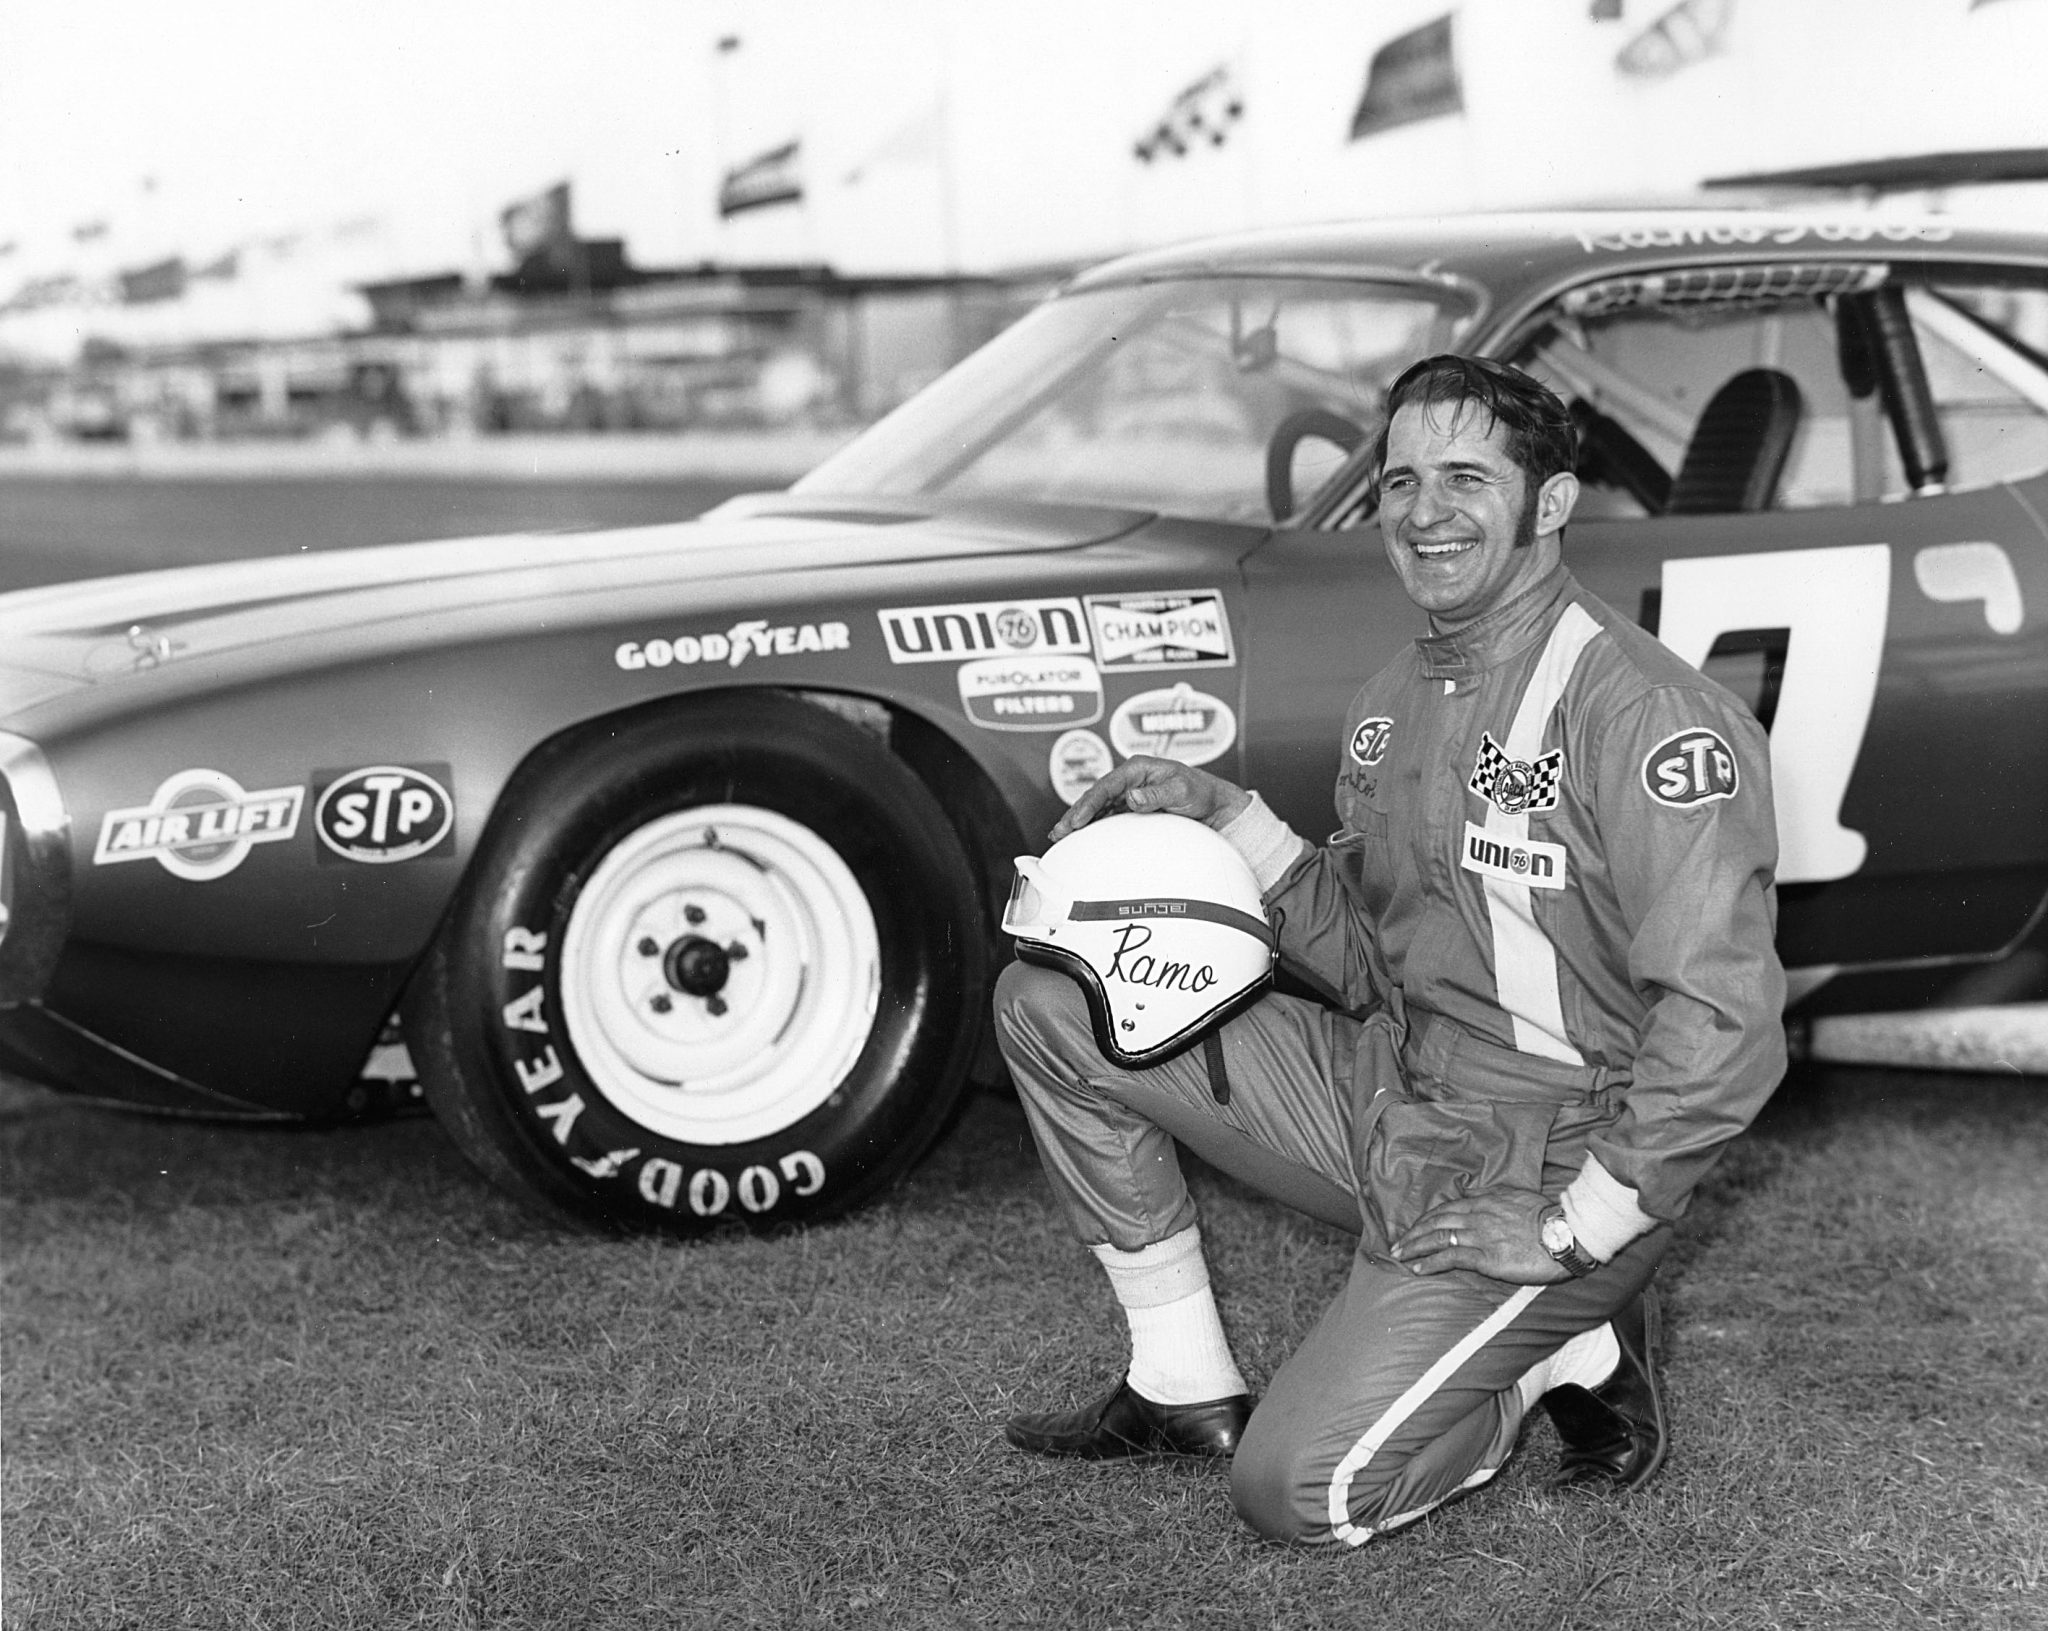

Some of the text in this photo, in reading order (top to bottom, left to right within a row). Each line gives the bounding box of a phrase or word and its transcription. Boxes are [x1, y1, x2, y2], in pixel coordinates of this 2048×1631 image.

[615, 620, 850, 670] GOODYEAR
[1102, 618, 1217, 642] CHAMPION
[1658, 544, 1890, 885] 7
[1502, 781, 1525, 797] ARCA
[1656, 737, 1734, 799] STP
[111, 800, 291, 850] AIR LIFT
[332, 775, 434, 844] STP
[1512, 853, 1527, 869] 76
[1105, 923, 1219, 993] Ramo
